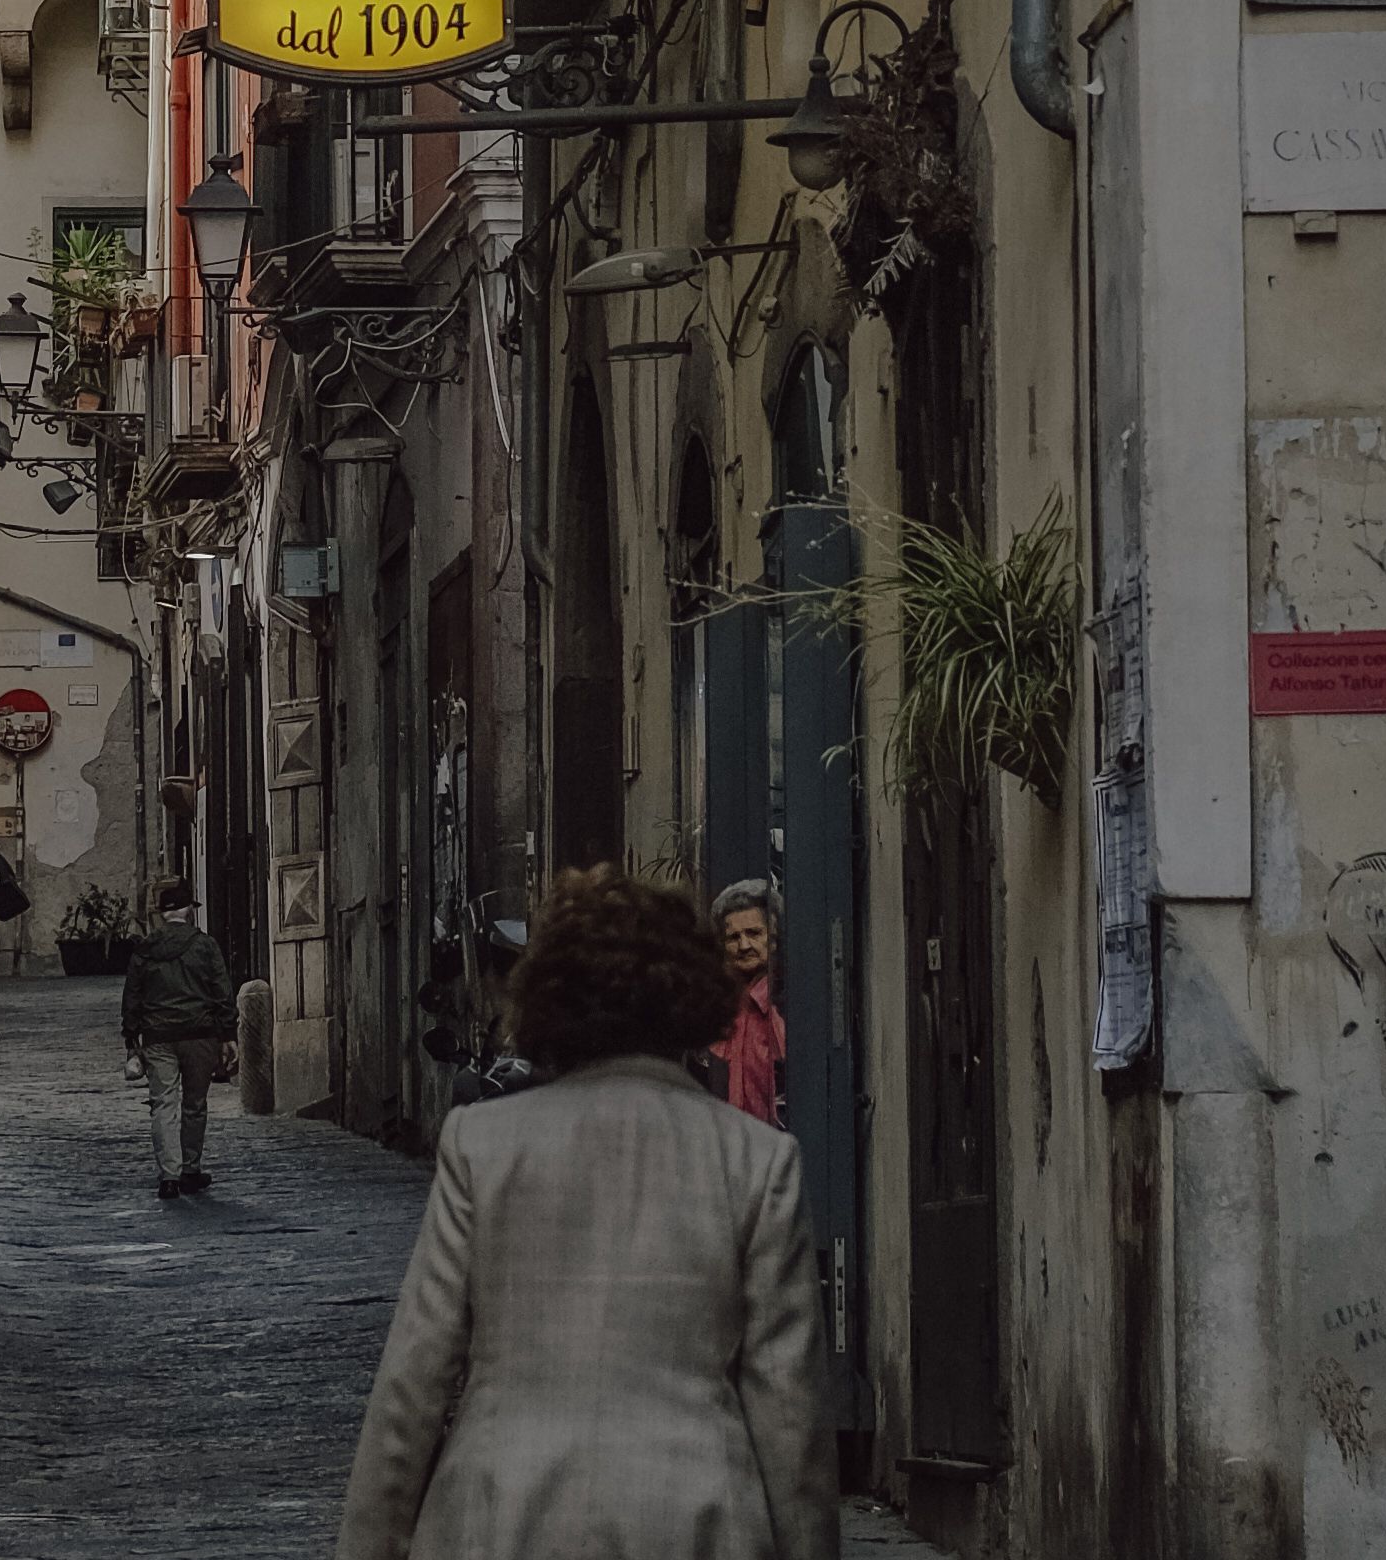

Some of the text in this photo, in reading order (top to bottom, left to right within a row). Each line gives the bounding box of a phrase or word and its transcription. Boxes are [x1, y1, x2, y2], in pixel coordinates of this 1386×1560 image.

[276, 1, 471, 58] dal 1904
[1267, 653, 1359, 668] Collezione
[1269, 676, 1335, 691] Alfonso
